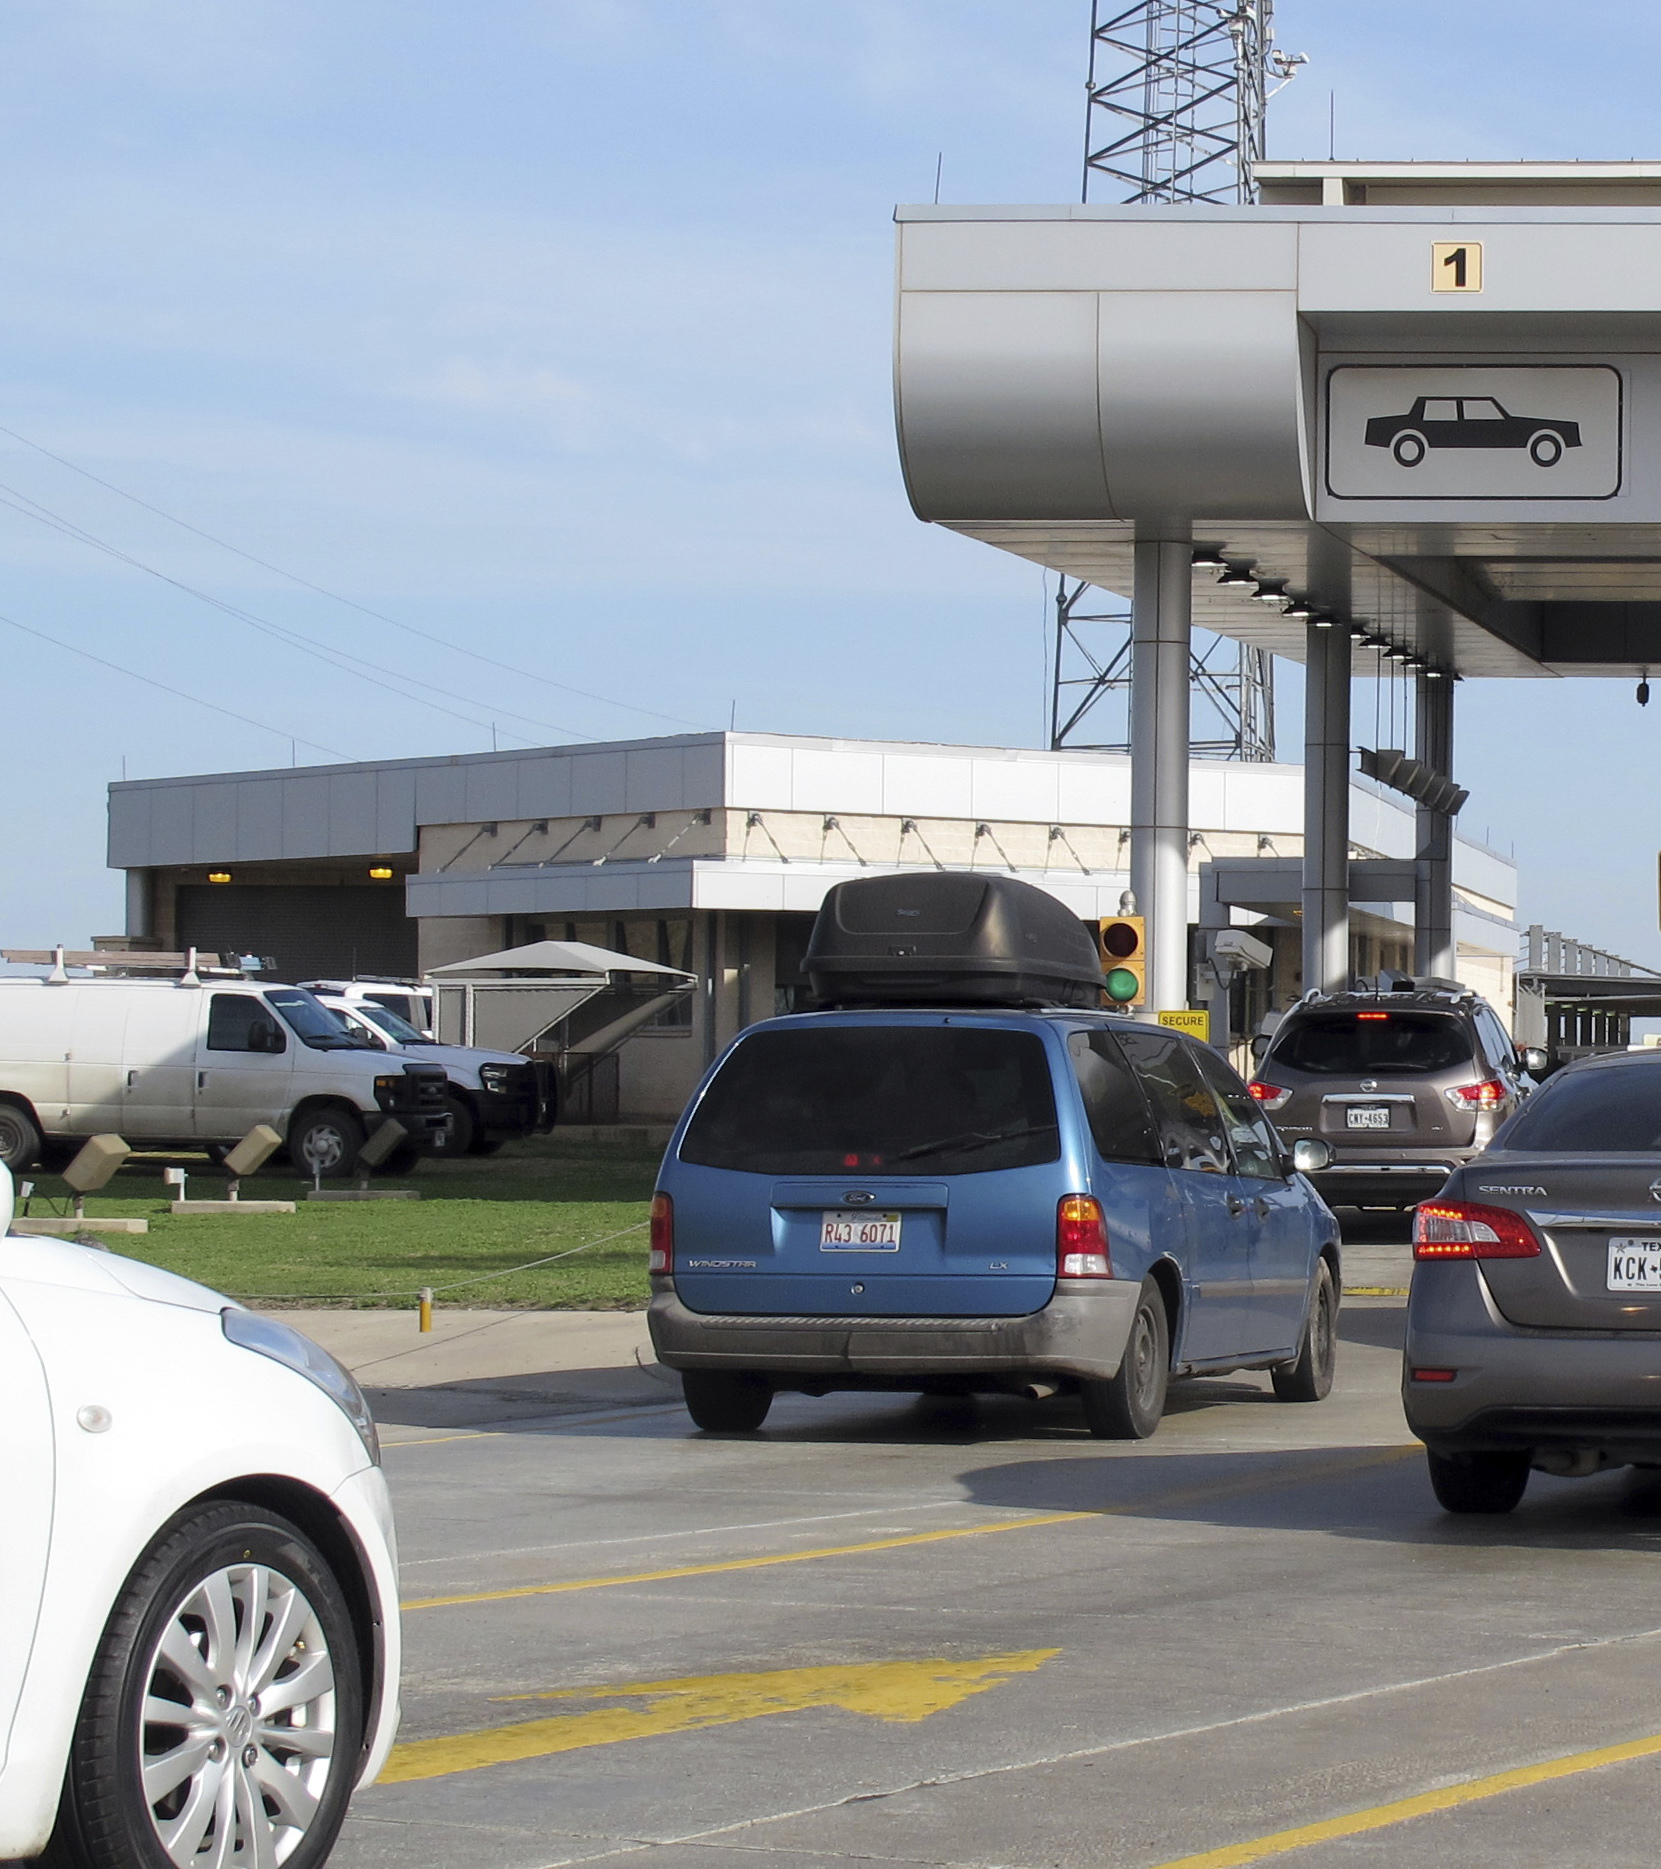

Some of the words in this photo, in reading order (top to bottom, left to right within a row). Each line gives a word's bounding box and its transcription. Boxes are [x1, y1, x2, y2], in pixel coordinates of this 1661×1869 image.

[1444, 248, 1466, 287] 1
[1162, 1016, 1204, 1026] SECURE
[1479, 1185, 1548, 1197] SENTRA
[824, 1223, 852, 1243] R43
[860, 1223, 895, 1243] 6071
